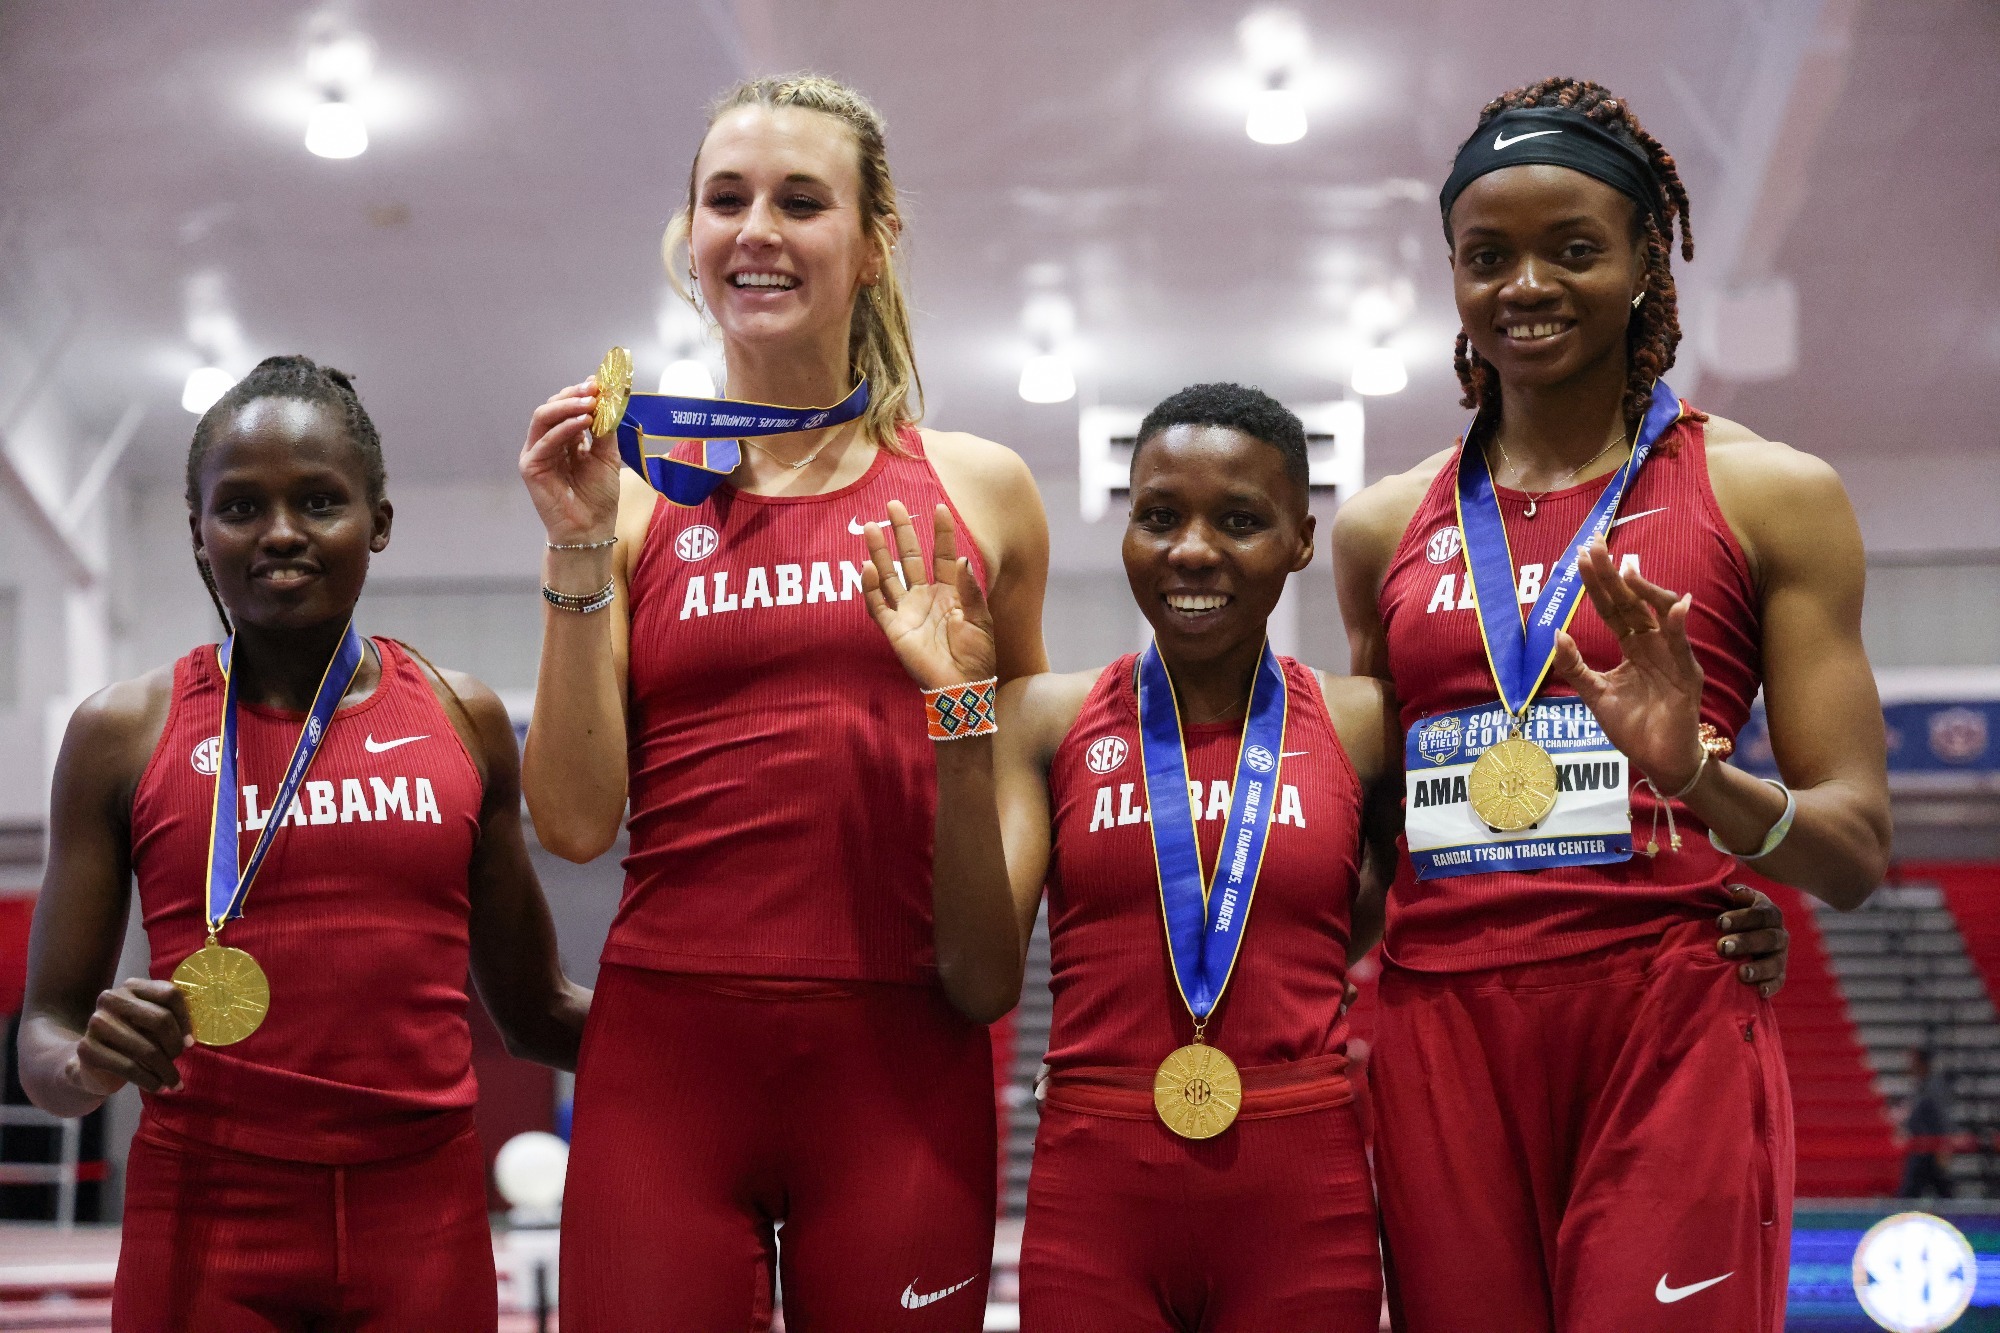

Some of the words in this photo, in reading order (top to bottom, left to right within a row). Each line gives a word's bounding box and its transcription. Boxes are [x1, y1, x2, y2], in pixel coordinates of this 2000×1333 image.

[671, 411, 707, 425] LEADERS.
[711, 414, 756, 427] CHAMPIONS.
[758, 417, 799, 428] SCHOLARS.
[676, 526, 717, 560] SEC
[1428, 527, 1462, 562] SEC
[1561, 536, 1595, 583] CHPIONS.
[680, 561, 907, 620] ALABAM
[1537, 587, 1568, 627] LEADERS.
[1421, 730, 1460, 741] TRACK
[1430, 737, 1459, 749] FIELD
[1465, 721, 1606, 747] CONERENC
[1465, 745, 1491, 757] INDOO
[1545, 737, 1610, 748] CHAMPIONSHIPS
[192, 737, 222, 774] SE
[1088, 737, 1126, 772] SEC
[1246, 746, 1274, 771] SEC
[237, 777, 441, 832] LABAMA
[1089, 780, 1306, 832] ALBAA
[1242, 780, 1263, 825] SCHOLARS.
[1228, 828, 1252, 884] CHAMPIONS.
[1432, 849, 1472, 867] RANDAL
[1474, 846, 1513, 861] TYSON
[1515, 843, 1556, 858] TRACK
[1558, 840, 1606, 855] CENTER
[1215, 888, 1238, 932] LEADERS.
[1184, 1078, 1211, 1106] SEC
